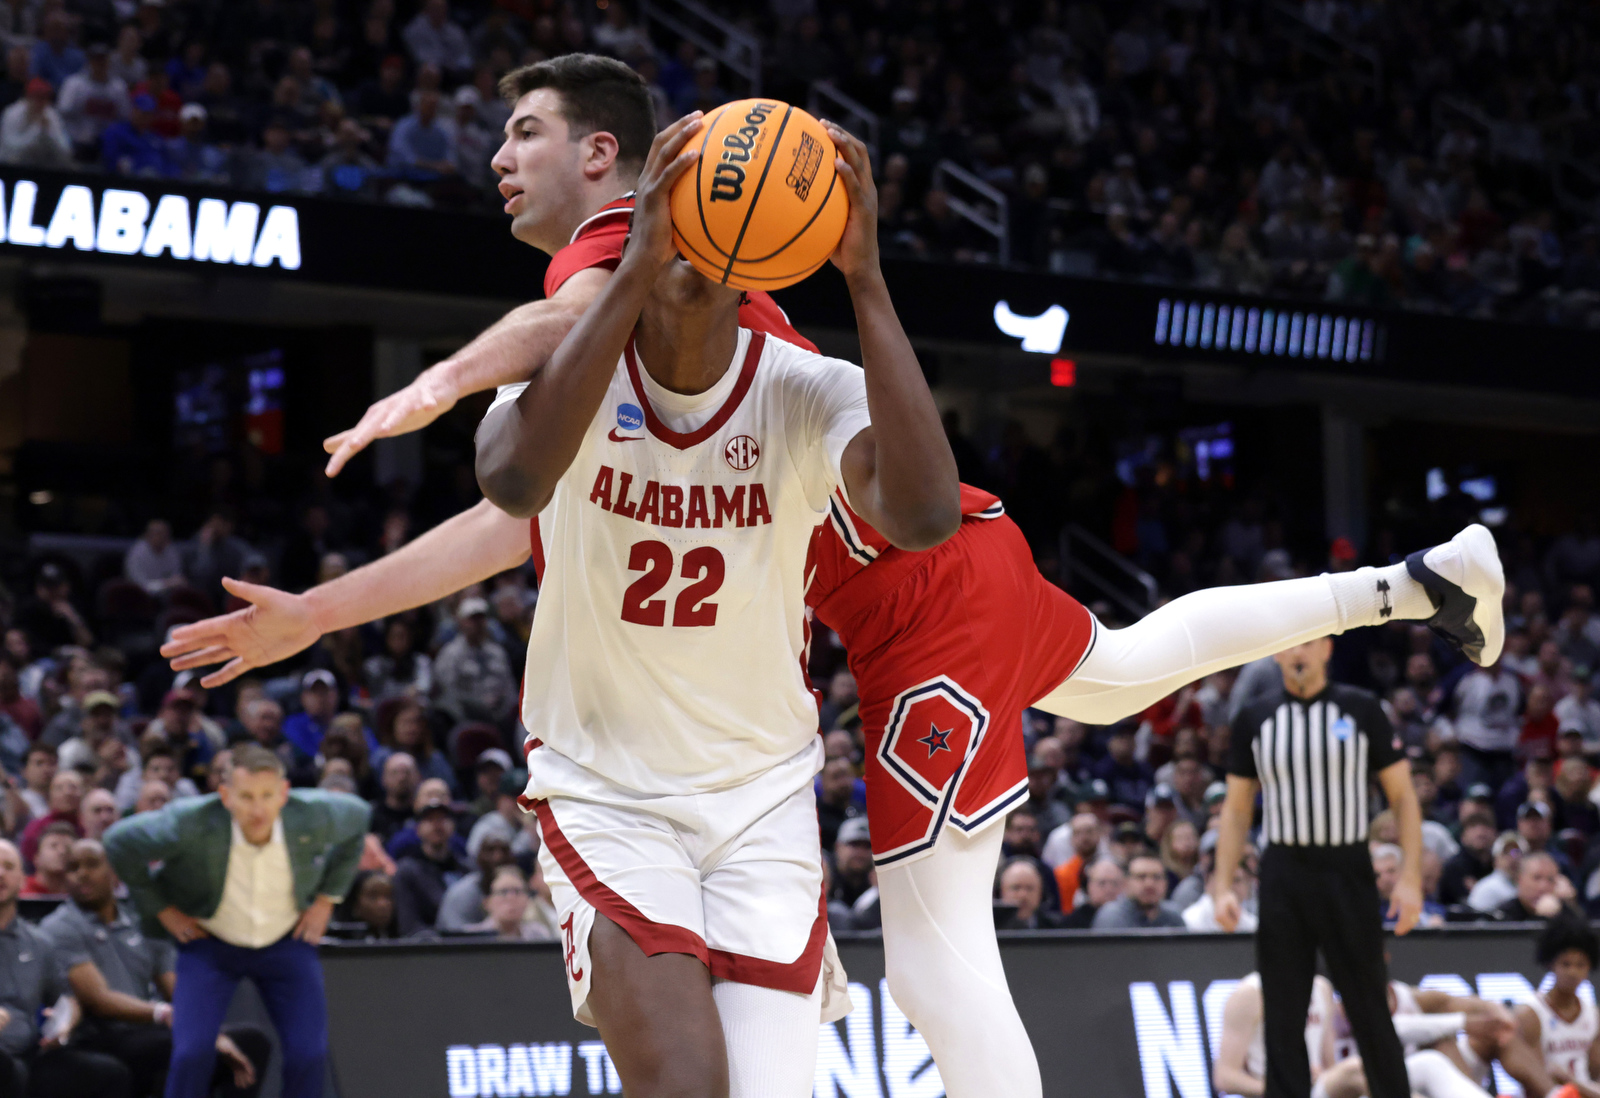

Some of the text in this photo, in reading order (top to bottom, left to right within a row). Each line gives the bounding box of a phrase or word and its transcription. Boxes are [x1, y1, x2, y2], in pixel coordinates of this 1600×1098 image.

[709, 102, 778, 203] Wilson
[0, 178, 301, 270] LABAMA
[617, 413, 641, 426] NCAA
[727, 436, 758, 469] SEC
[589, 465, 772, 528] ALABAMA
[620, 540, 726, 627] 22
[446, 1041, 573, 1097] DRAW
